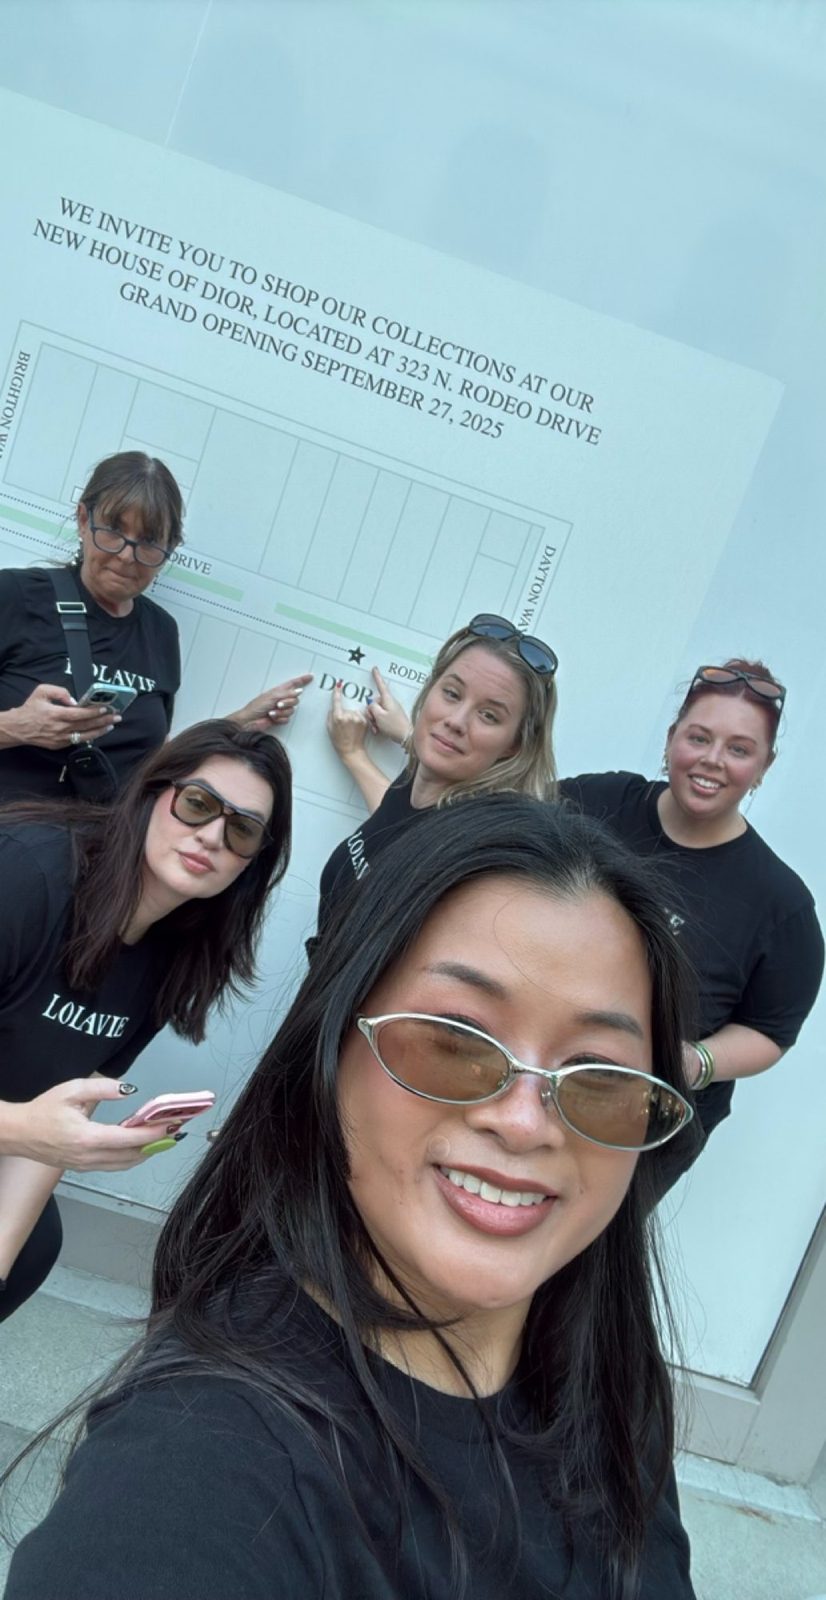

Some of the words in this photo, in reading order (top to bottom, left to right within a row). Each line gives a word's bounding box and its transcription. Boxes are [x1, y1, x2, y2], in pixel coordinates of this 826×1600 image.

[32, 218, 86, 250] NEW
[89, 239, 165, 282] HOUSE
[167, 269, 199, 293] OF
[200, 281, 258, 320] DIOR,
[263, 305, 362, 356] LOCATED
[365, 345, 394, 367] AT
[396, 356, 430, 382] 323
[432, 368, 452, 391] N.
[458, 378, 533, 420] RODEO
[535, 408, 603, 446] DRIVE
[60, 197, 94, 225] WE
[96, 211, 173, 254] INVITE
[178, 241, 226, 273] YOU
[229, 260, 258, 285] TO
[261, 274, 320, 308] SHOP
[321, 296, 367, 329] OUR
[372, 316, 516, 383] COLLECTIONS
[518, 373, 548, 395] AT
[550, 383, 595, 413] OUR
[0, 351, 31, 430] BRIGHTON
[119, 282, 198, 324] GRAND
[202, 313, 299, 362] OPENING
[301, 350, 425, 411] SEPTEMBER
[428, 397, 455, 425] 27,
[459, 410, 505, 439] 2025
[527, 544, 557, 605] DAYTON
[319, 673, 373, 704] DOR
[42, 994, 130, 1038] LOLAVIE
